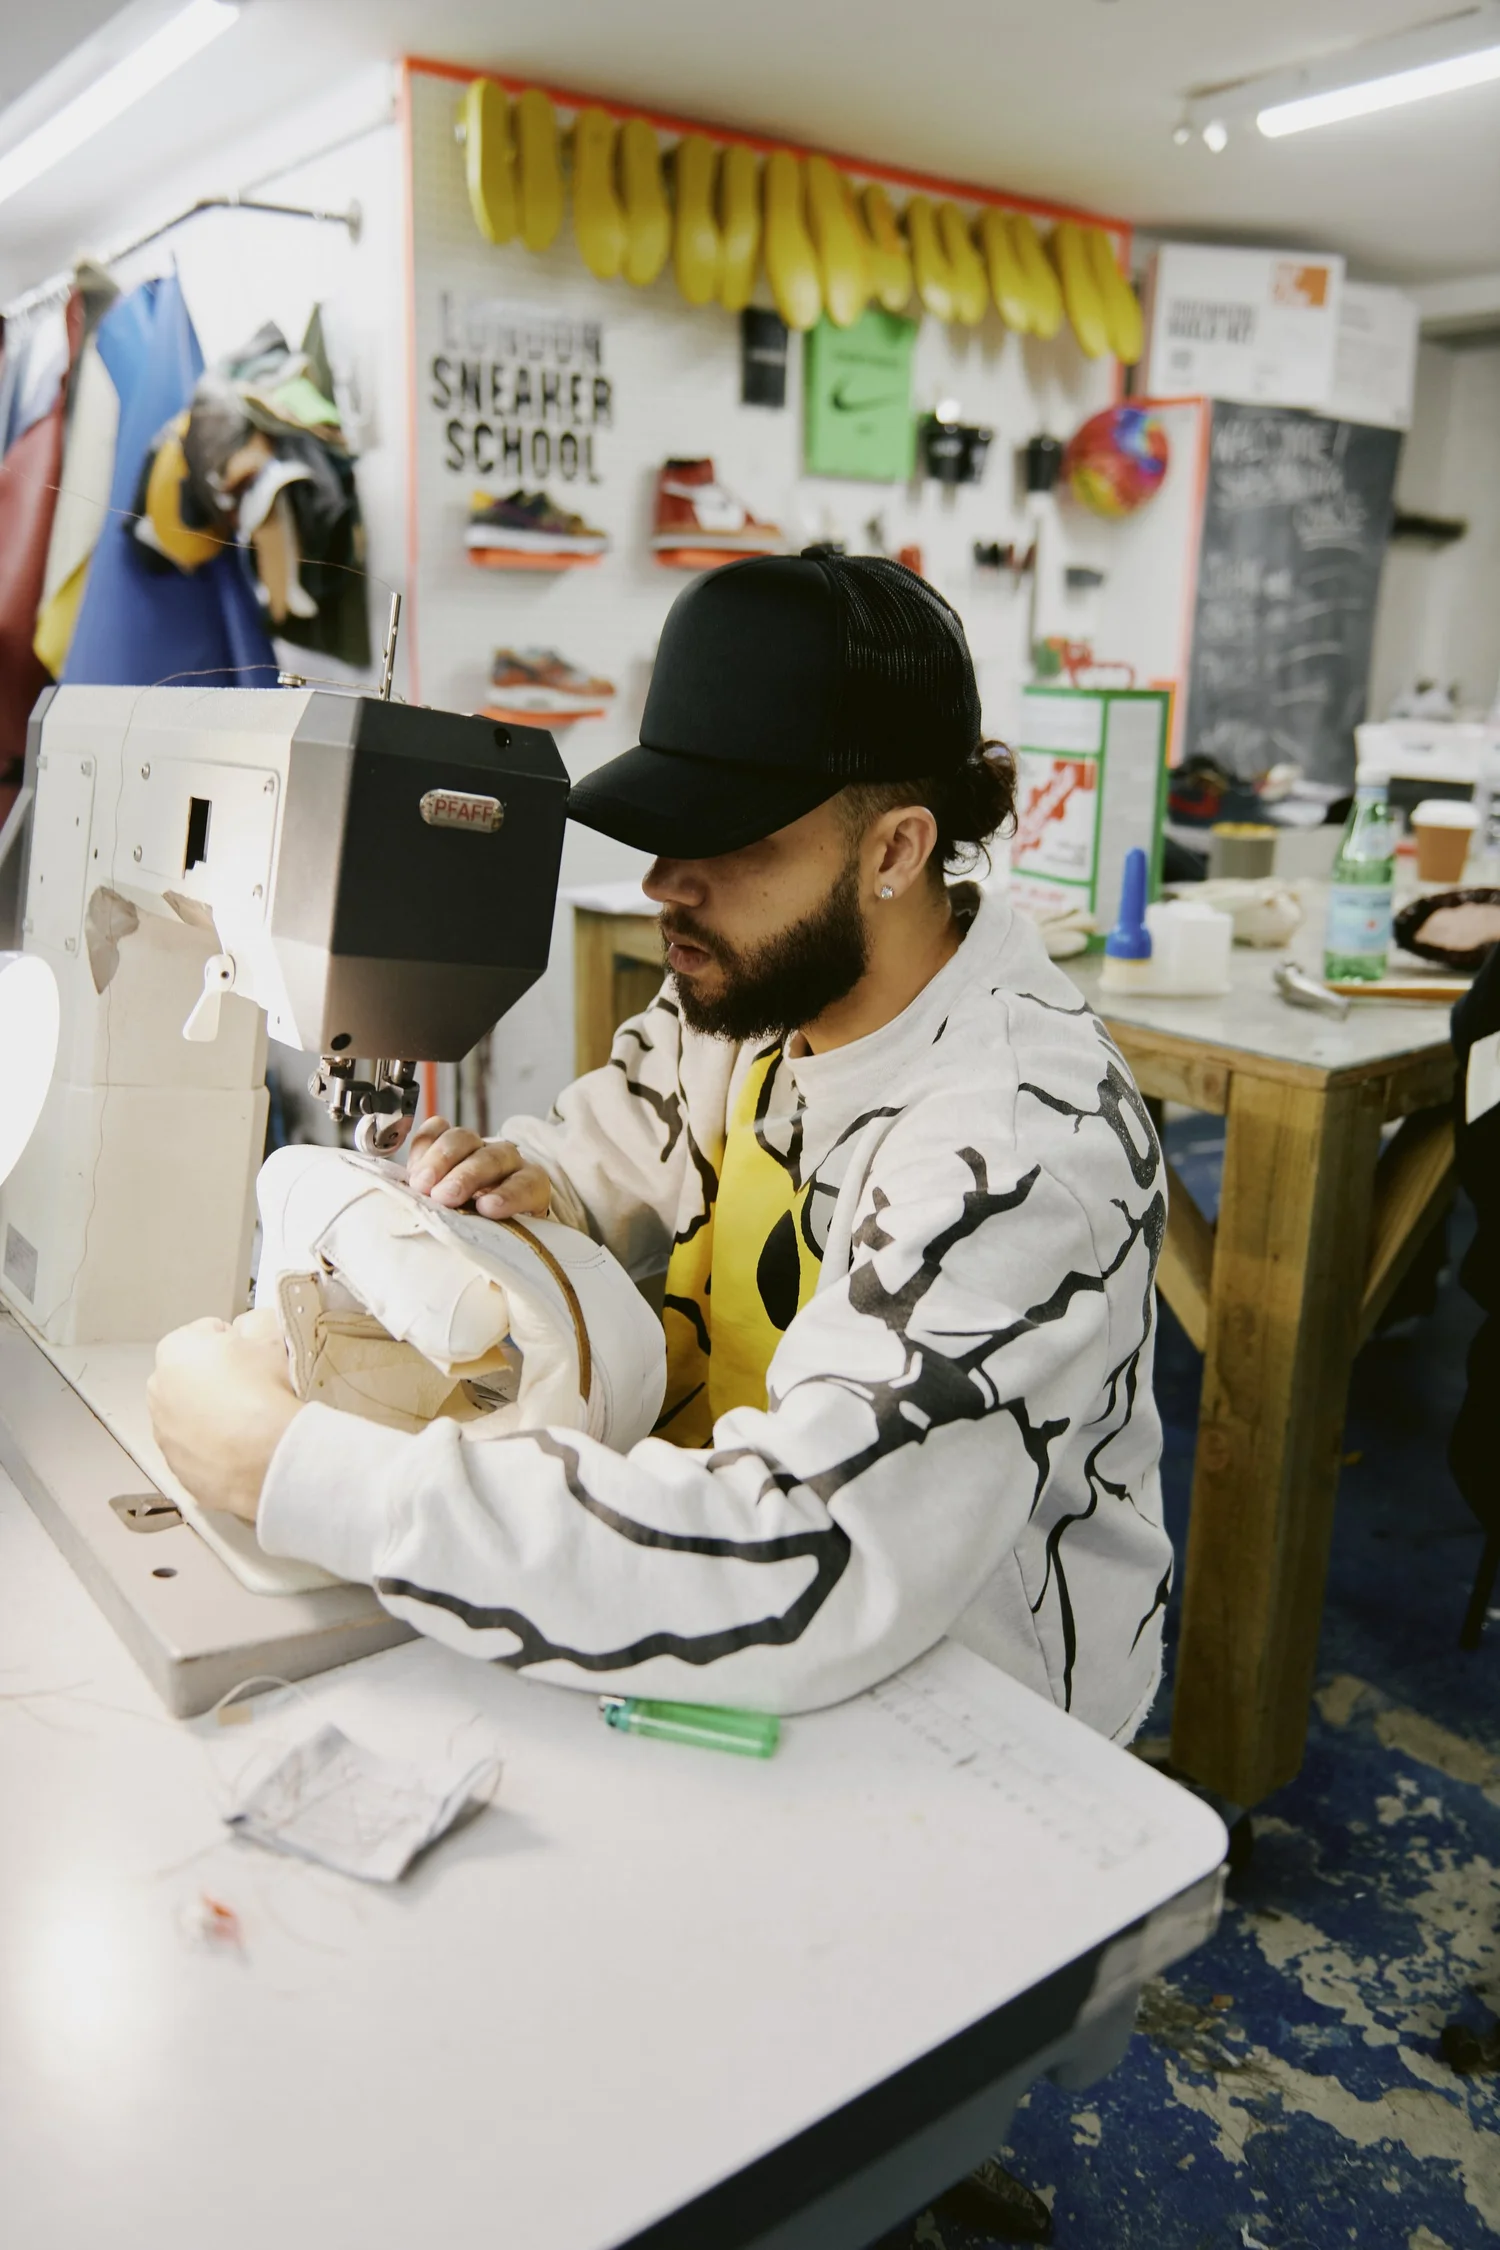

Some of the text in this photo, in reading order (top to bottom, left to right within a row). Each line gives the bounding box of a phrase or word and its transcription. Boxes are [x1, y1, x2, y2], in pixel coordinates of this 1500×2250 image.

[431, 355, 614, 427] SNEAKER
[445, 418, 602, 484] SCHOOL
[434, 798, 494, 823] PFAFF
